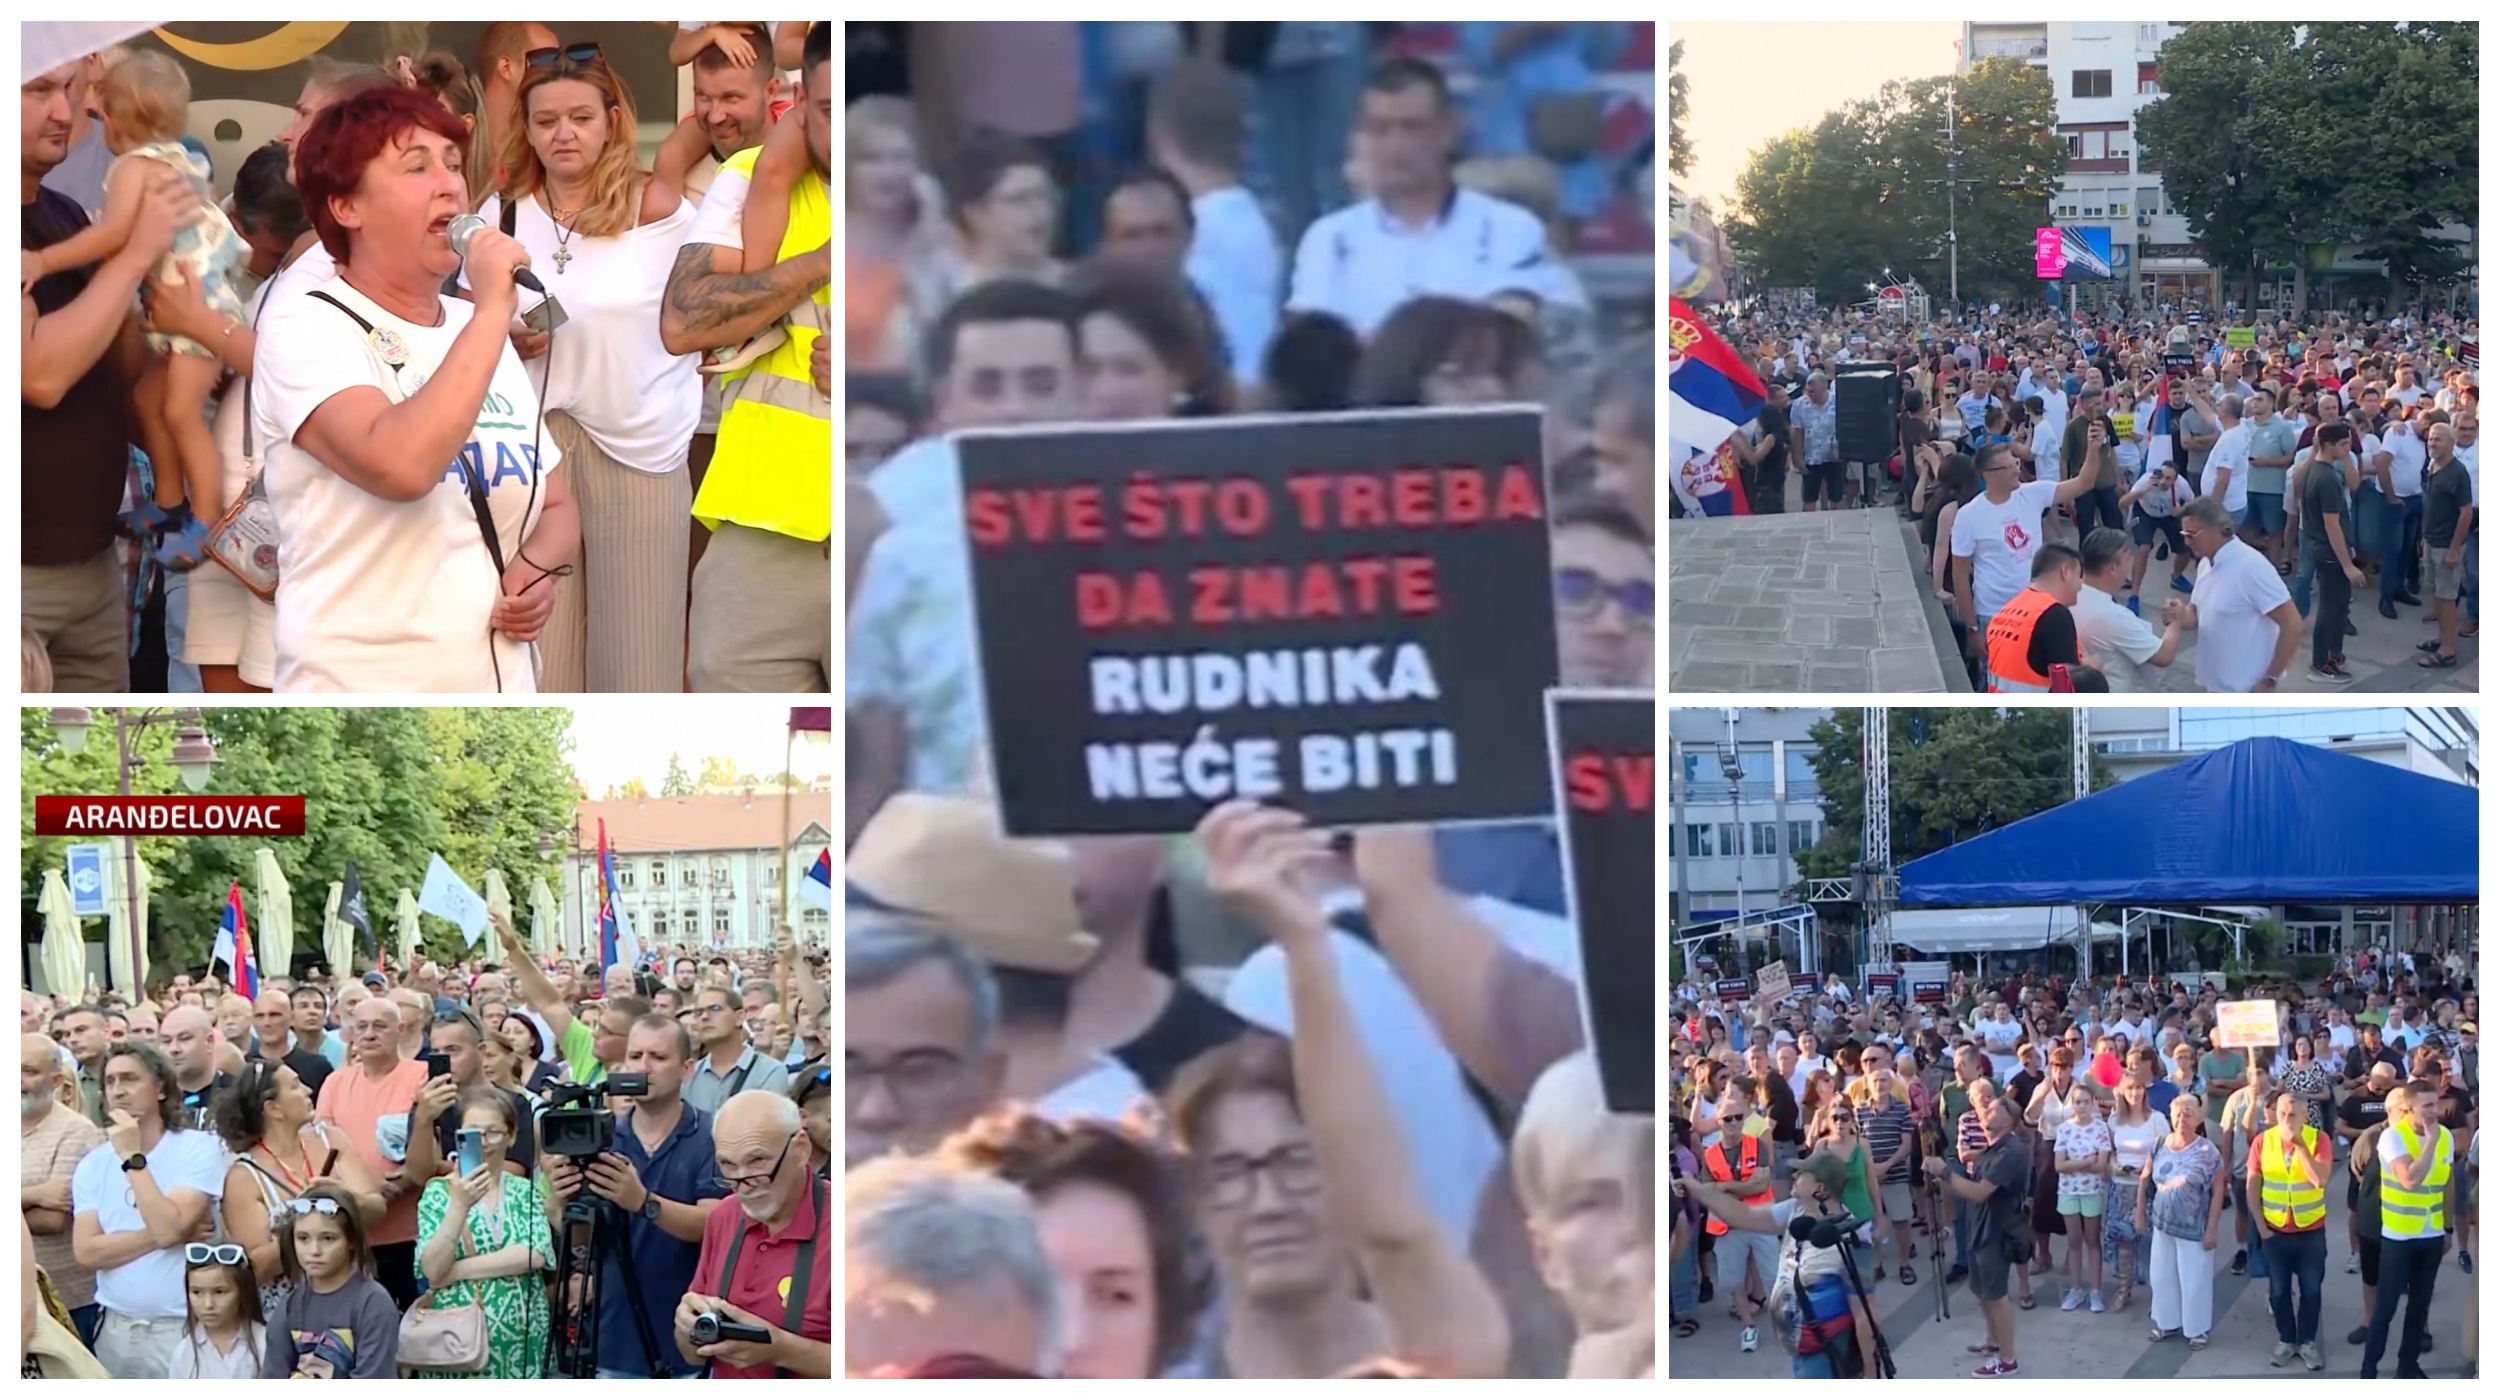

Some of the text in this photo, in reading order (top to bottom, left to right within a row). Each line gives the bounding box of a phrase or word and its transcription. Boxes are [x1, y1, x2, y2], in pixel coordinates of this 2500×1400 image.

[969, 464, 1542, 547] SVE ŠTO TREBA
[1076, 556, 1438, 628] DA ZNATE
[1089, 643, 1440, 714] RUDNIKA
[1084, 725, 1457, 799] NEĆE BITI
[1567, 754, 1655, 812] SV
